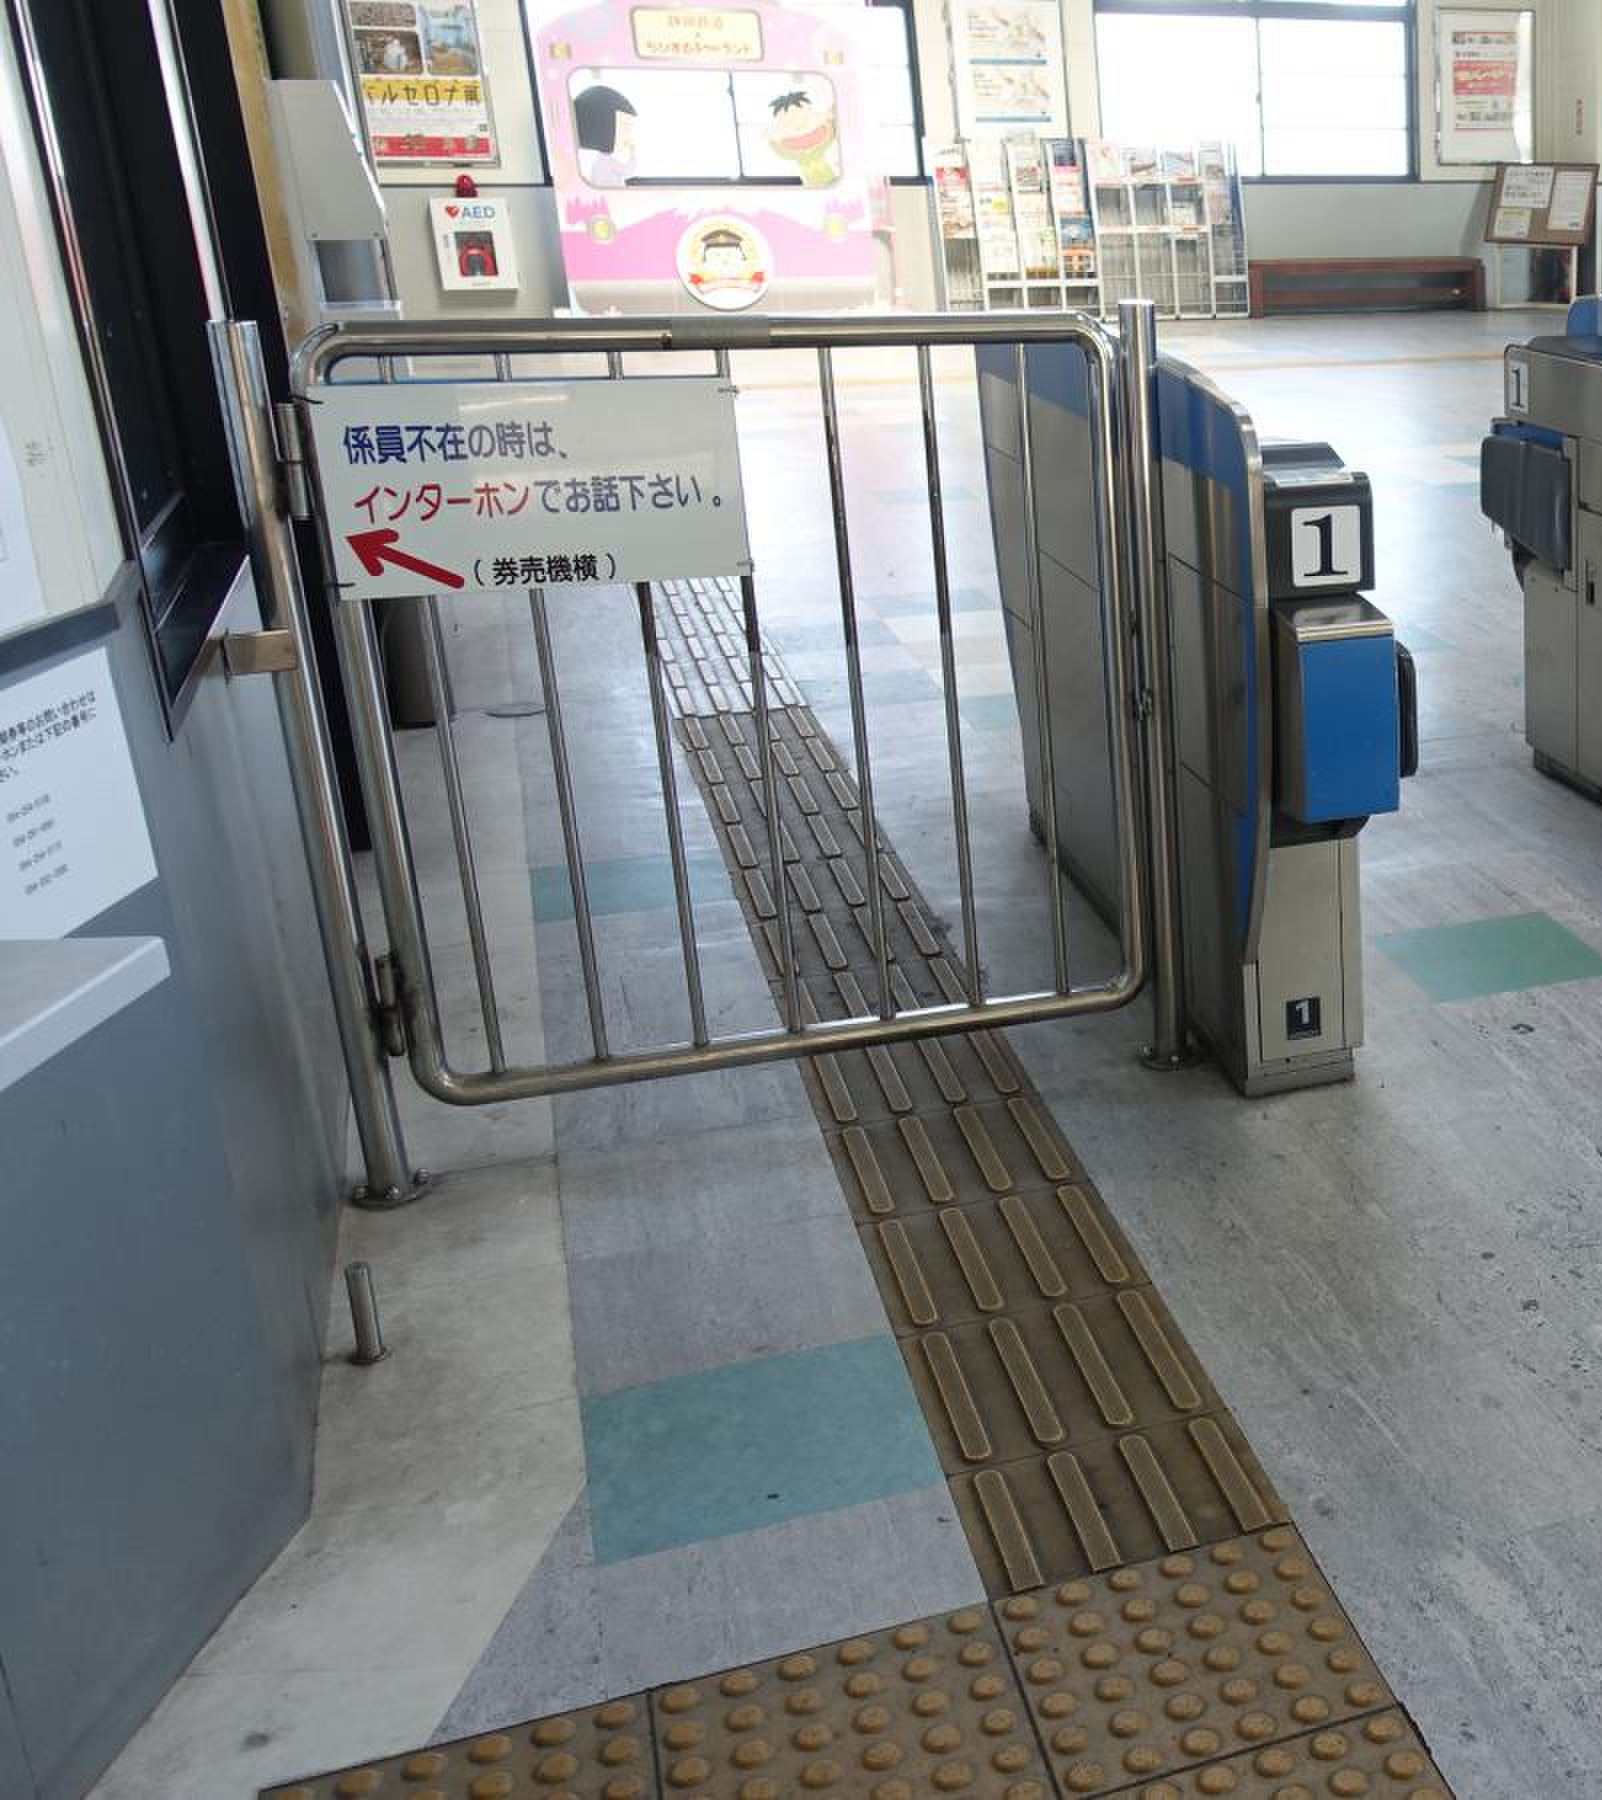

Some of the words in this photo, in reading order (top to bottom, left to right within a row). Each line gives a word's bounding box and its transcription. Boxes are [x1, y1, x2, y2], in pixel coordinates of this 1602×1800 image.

[462, 206, 496, 219] AED
[1511, 368, 1525, 408] 1
[343, 422, 568, 465] 係員不在の時は、
[353, 474, 722, 524] インターホンでお話下さい。
[1303, 513, 1349, 577] 1
[1296, 1000, 1309, 1025] 1
